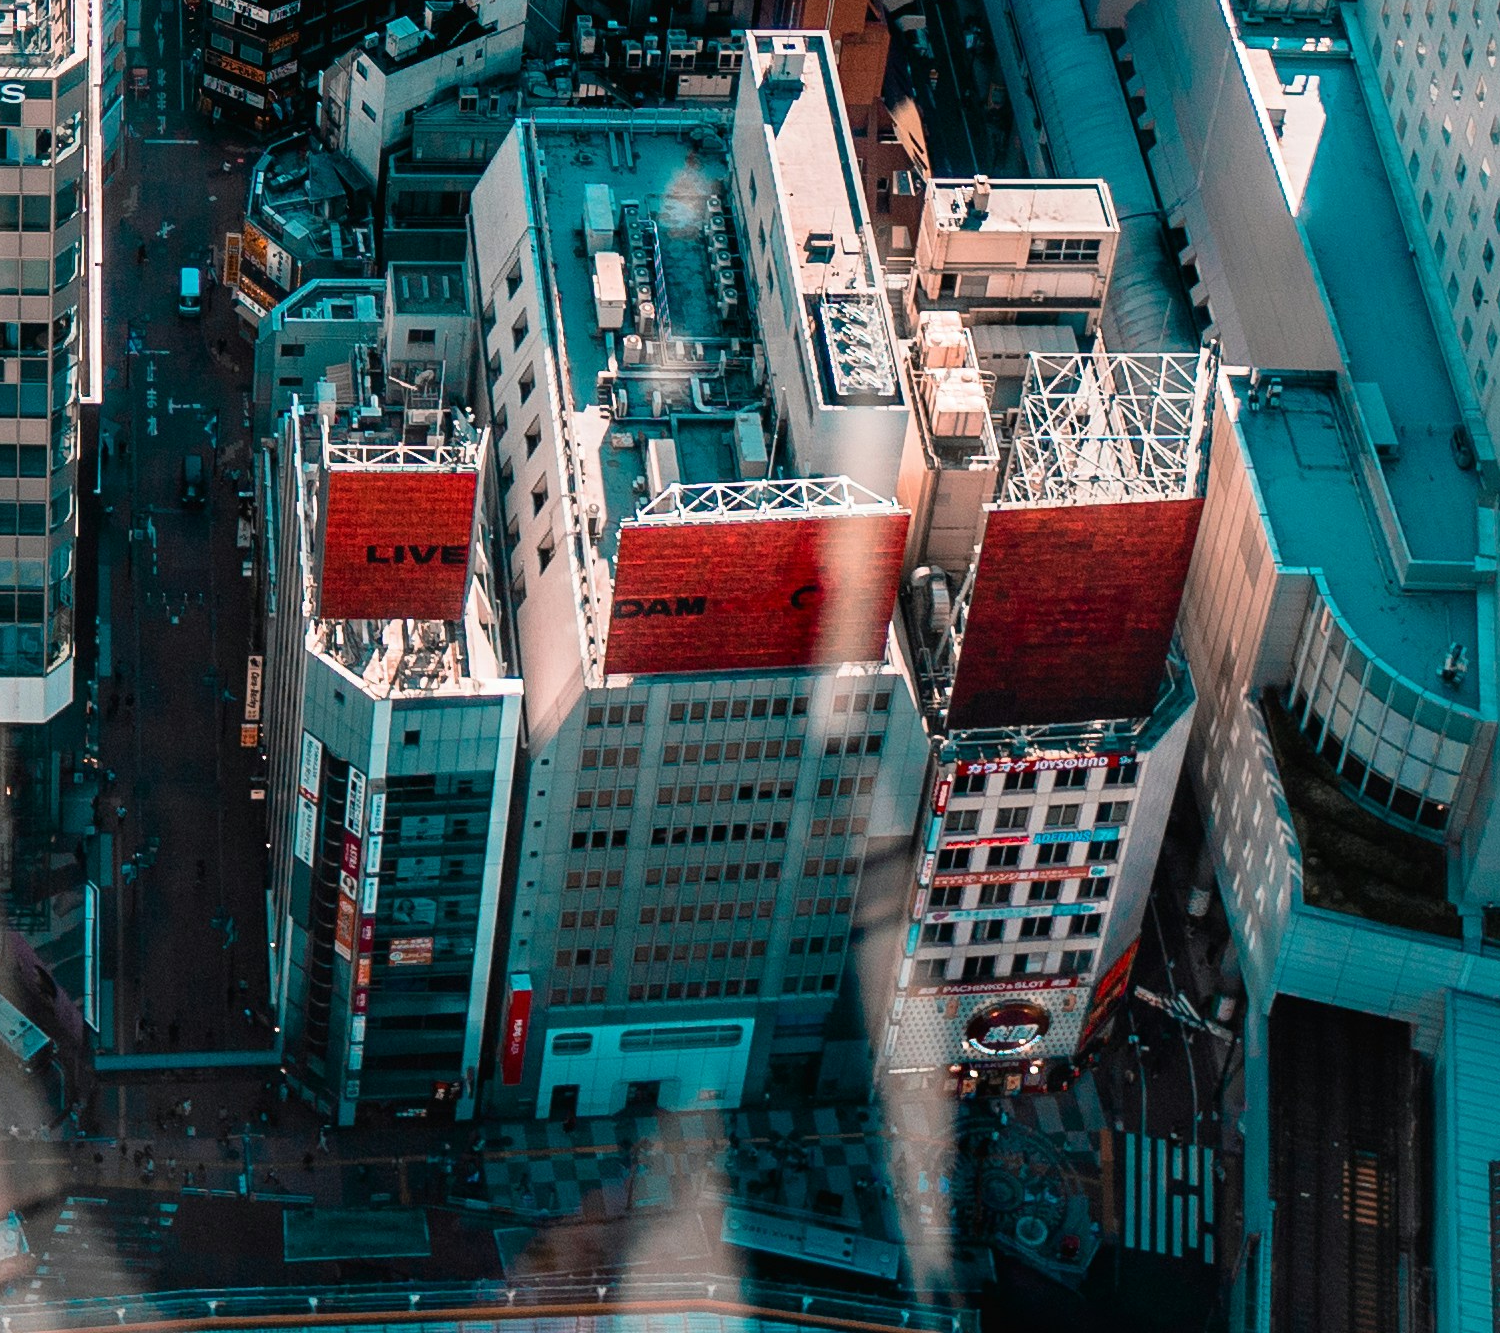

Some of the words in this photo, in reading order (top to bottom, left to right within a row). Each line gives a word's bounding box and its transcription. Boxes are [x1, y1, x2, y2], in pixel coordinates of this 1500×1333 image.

[366, 545, 467, 564] LIVE
[614, 595, 708, 620] DAM
[967, 761, 1030, 774] カラオケ
[1033, 756, 1108, 772] JOYSOUND
